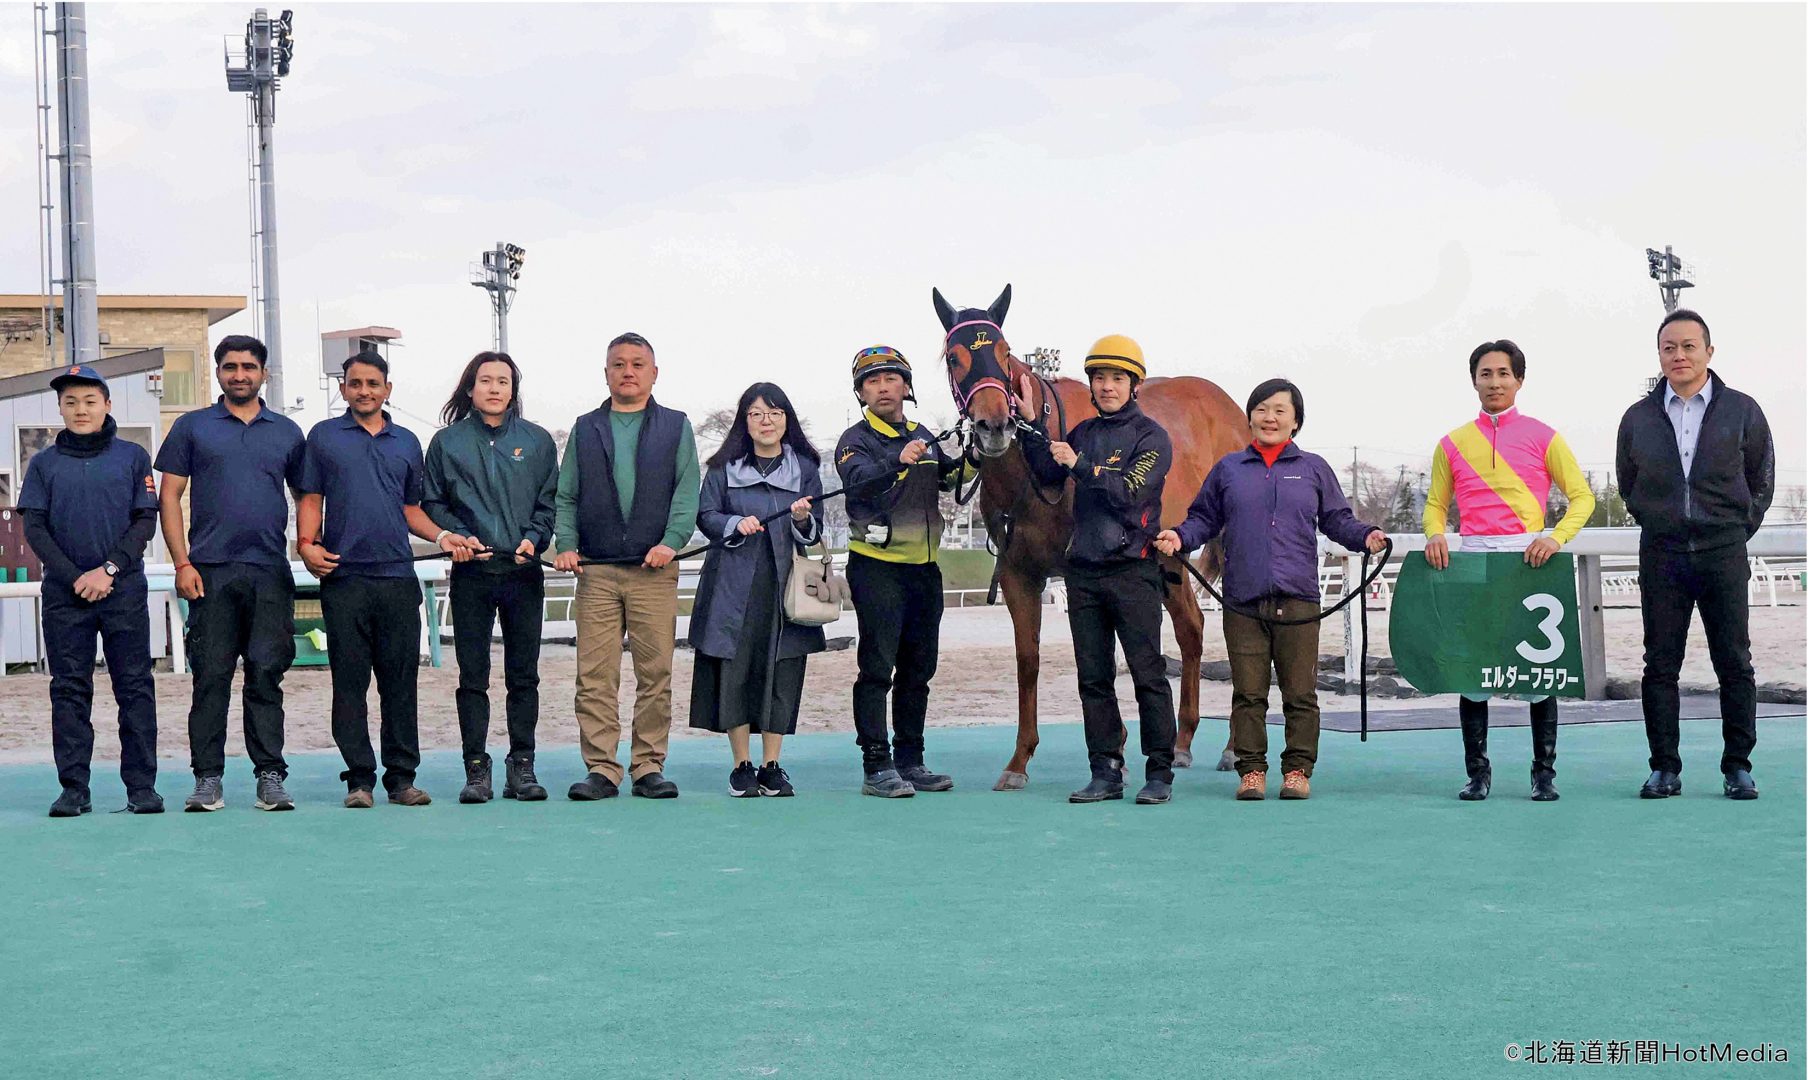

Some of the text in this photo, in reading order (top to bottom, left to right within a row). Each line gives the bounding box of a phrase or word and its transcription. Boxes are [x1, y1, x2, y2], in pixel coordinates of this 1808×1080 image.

[1515, 593, 1565, 664] 3
[1481, 666, 1579, 690] エルダーフラワー
